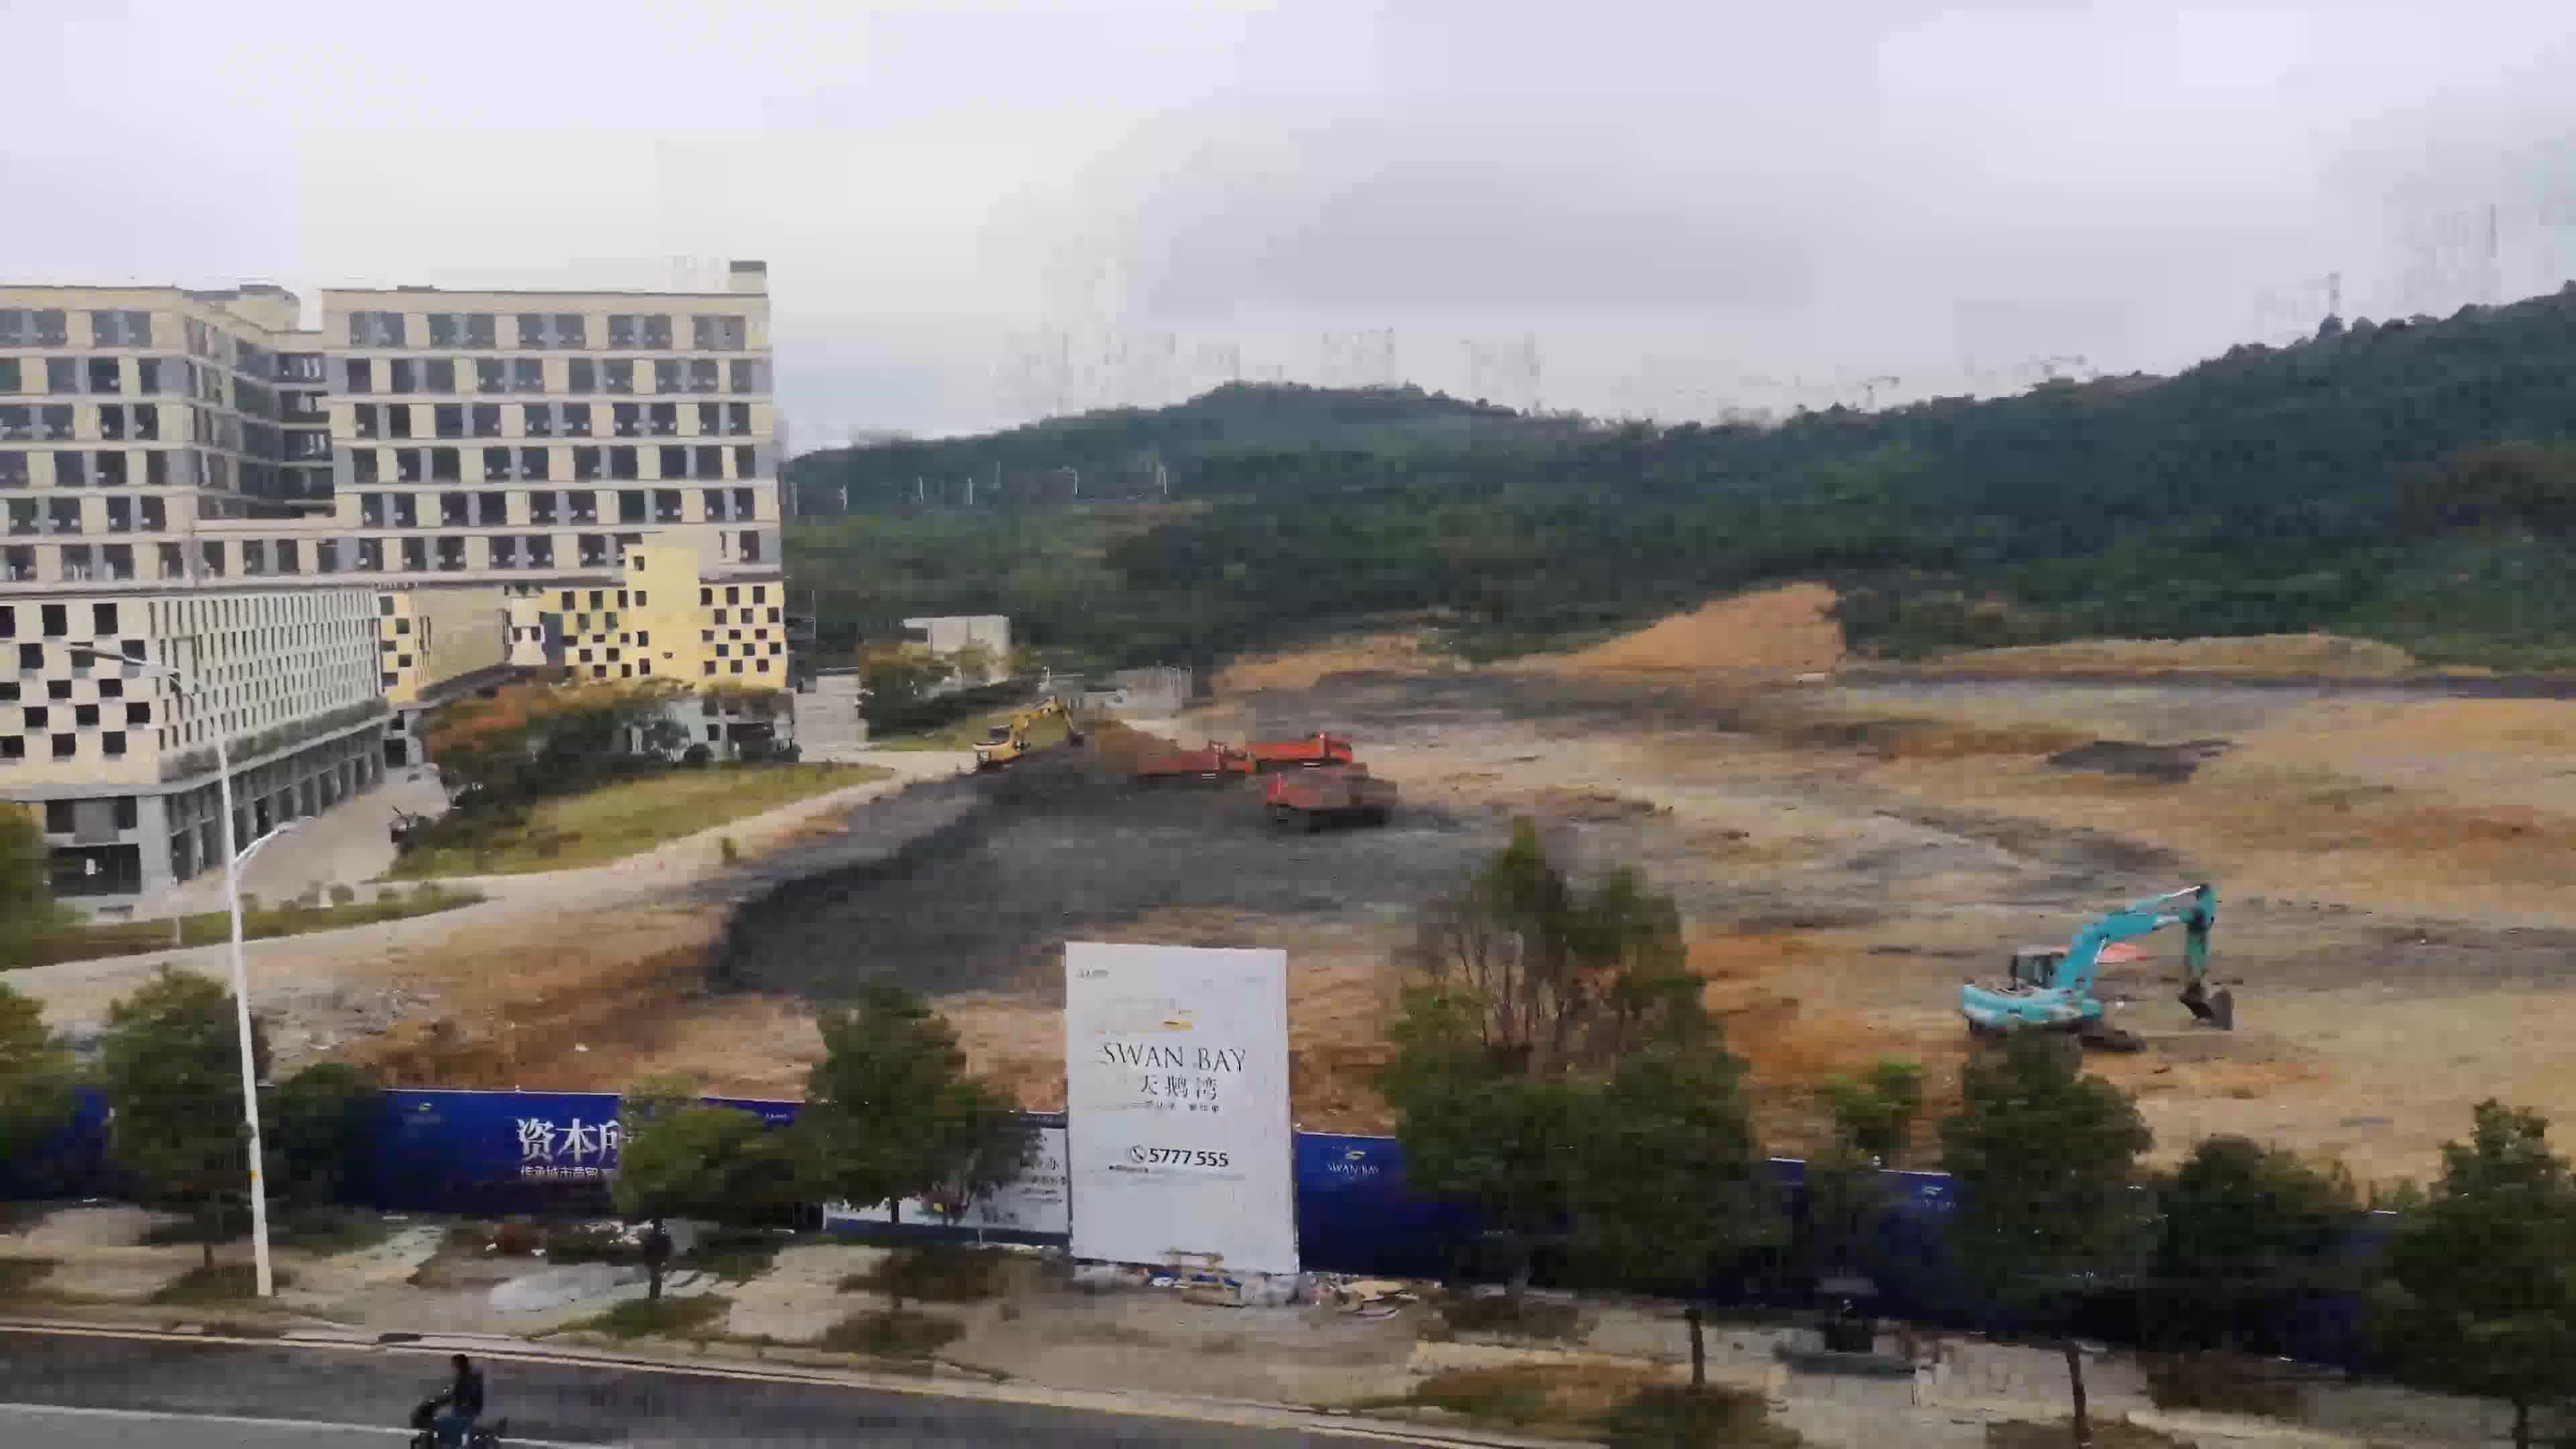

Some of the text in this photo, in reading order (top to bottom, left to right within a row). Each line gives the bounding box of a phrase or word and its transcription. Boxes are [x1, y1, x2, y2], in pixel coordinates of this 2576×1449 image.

[1104, 1041, 1246, 1073] SWAN BAY
[1148, 1148, 1229, 1167] 5777555
